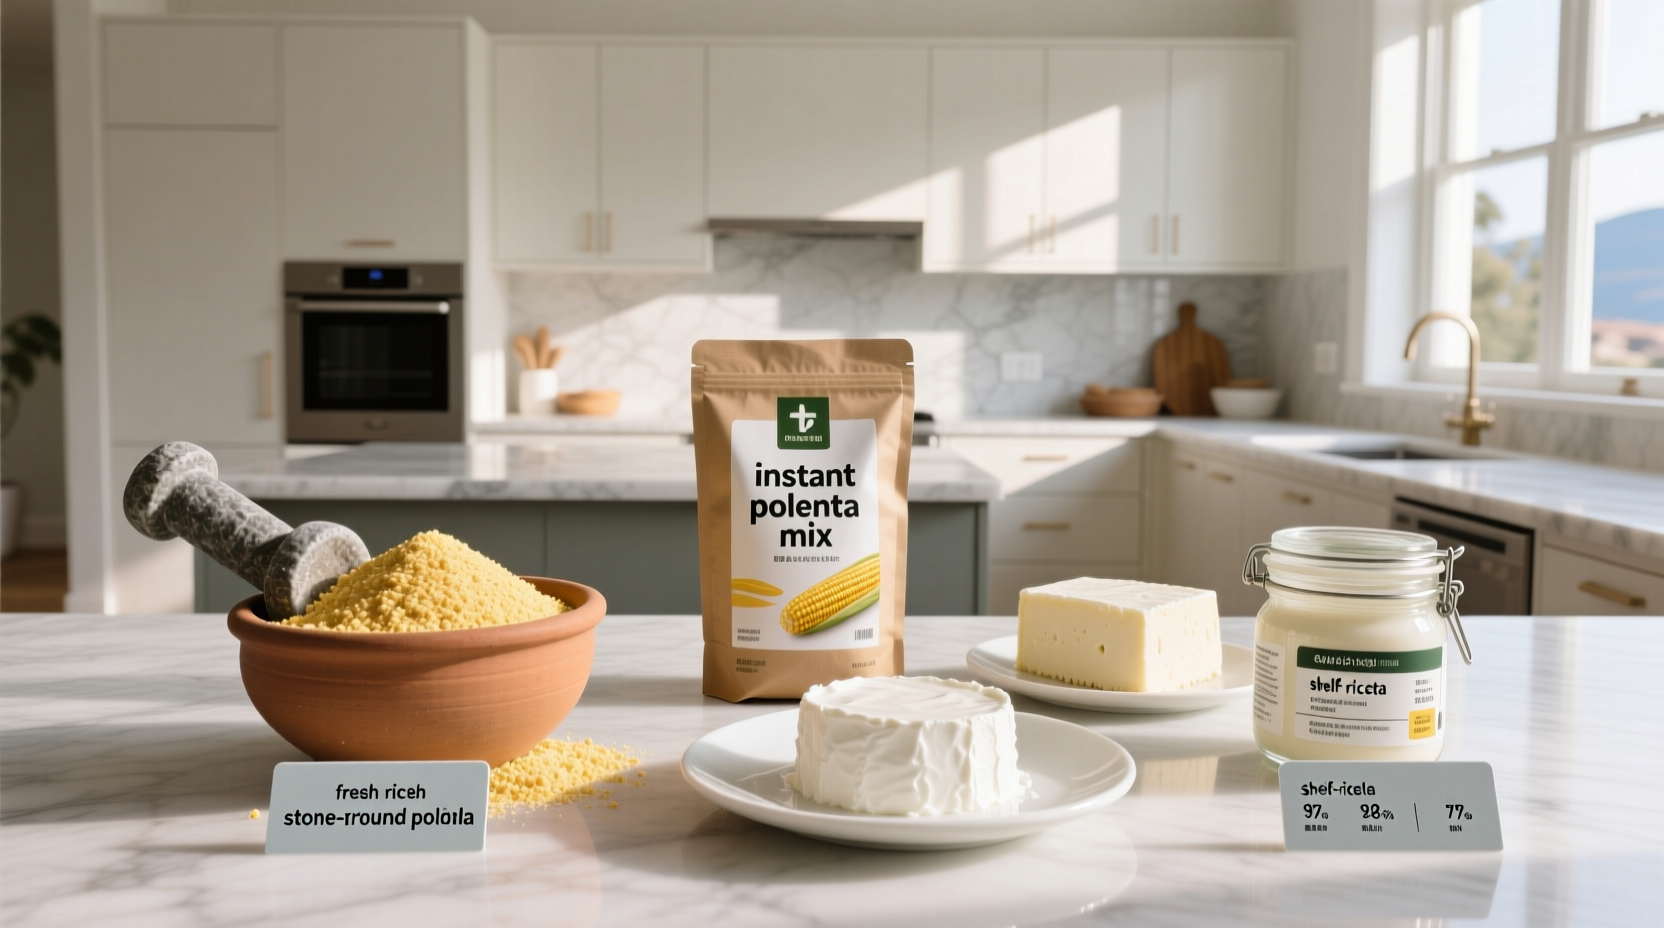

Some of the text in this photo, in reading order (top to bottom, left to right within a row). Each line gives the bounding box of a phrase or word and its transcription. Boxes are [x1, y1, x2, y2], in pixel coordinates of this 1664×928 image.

[755, 462, 856, 487] instant
[750, 493, 860, 525] polenta
[780, 521, 833, 548] mix
[336, 783, 426, 800] fresh riceh
